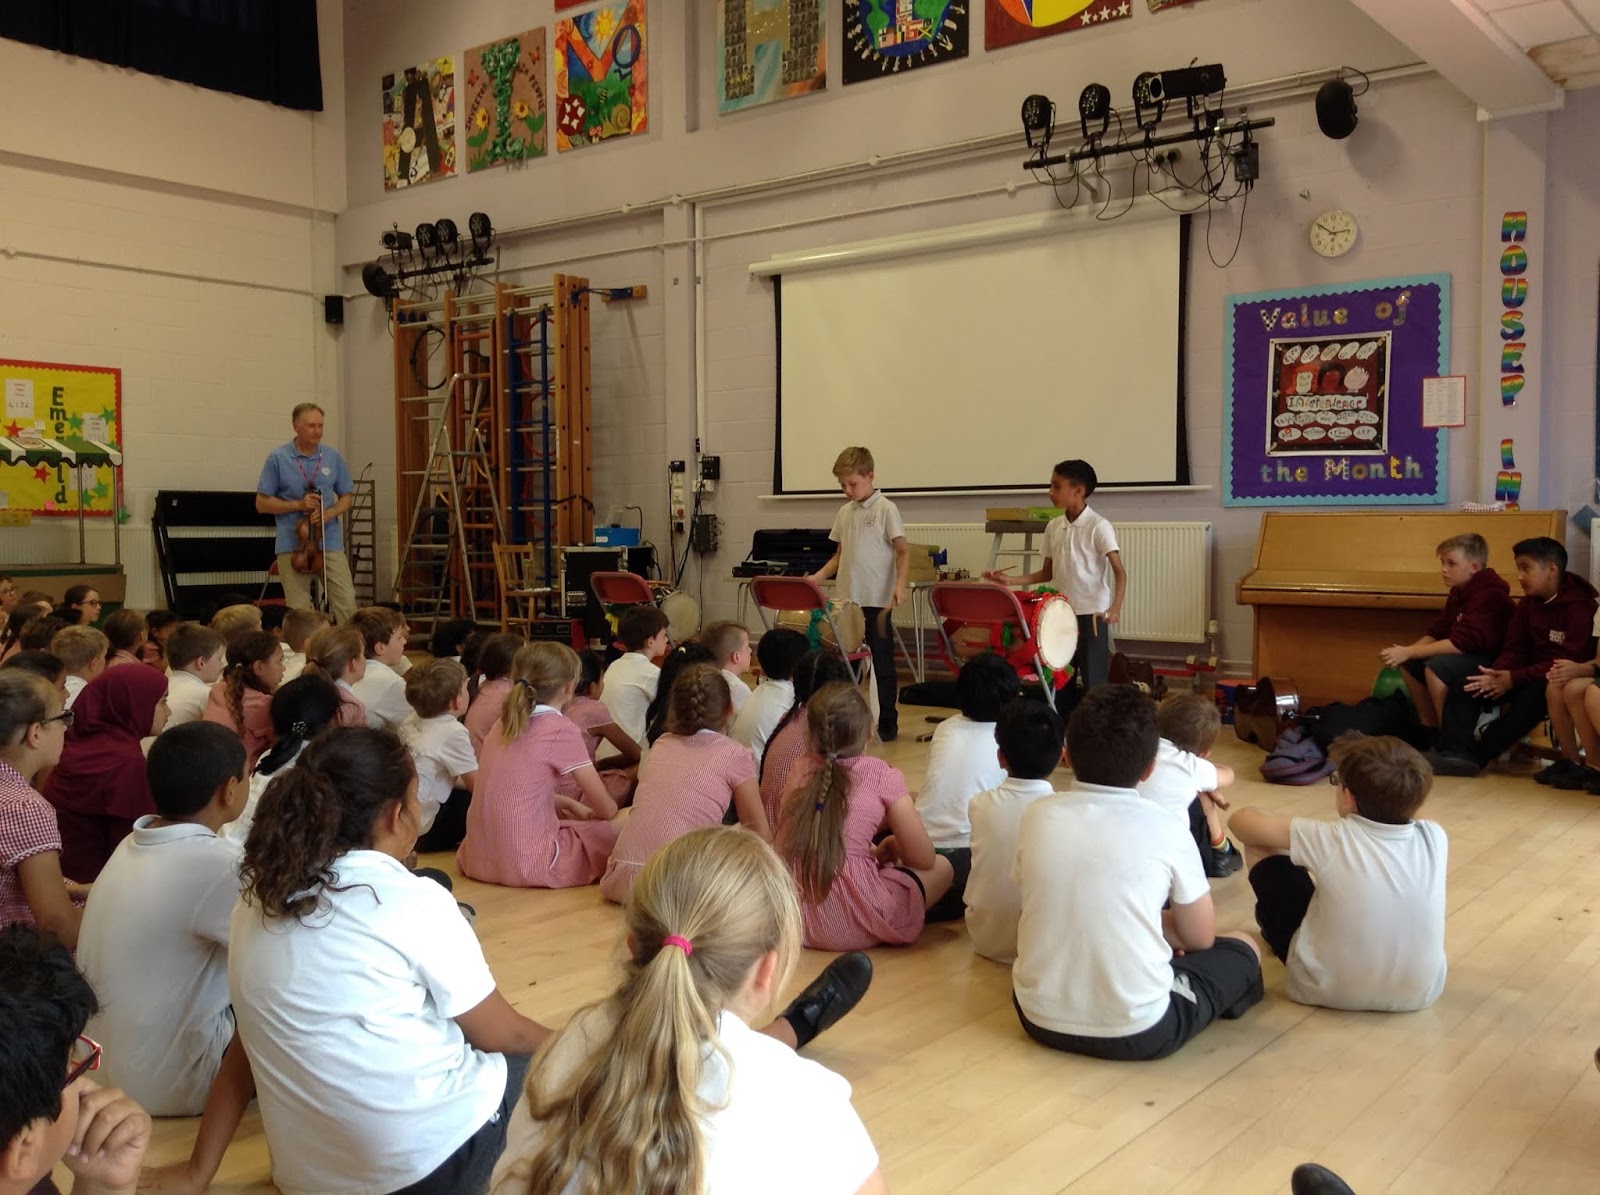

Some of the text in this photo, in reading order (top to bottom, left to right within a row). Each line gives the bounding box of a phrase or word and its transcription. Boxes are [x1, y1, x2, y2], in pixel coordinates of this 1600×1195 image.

[529, 73, 545, 111] PEOPLE
[1260, 290, 1411, 332] Value of
[50, 386, 69, 504] Emeld
[1260, 455, 1423, 483] the Month
